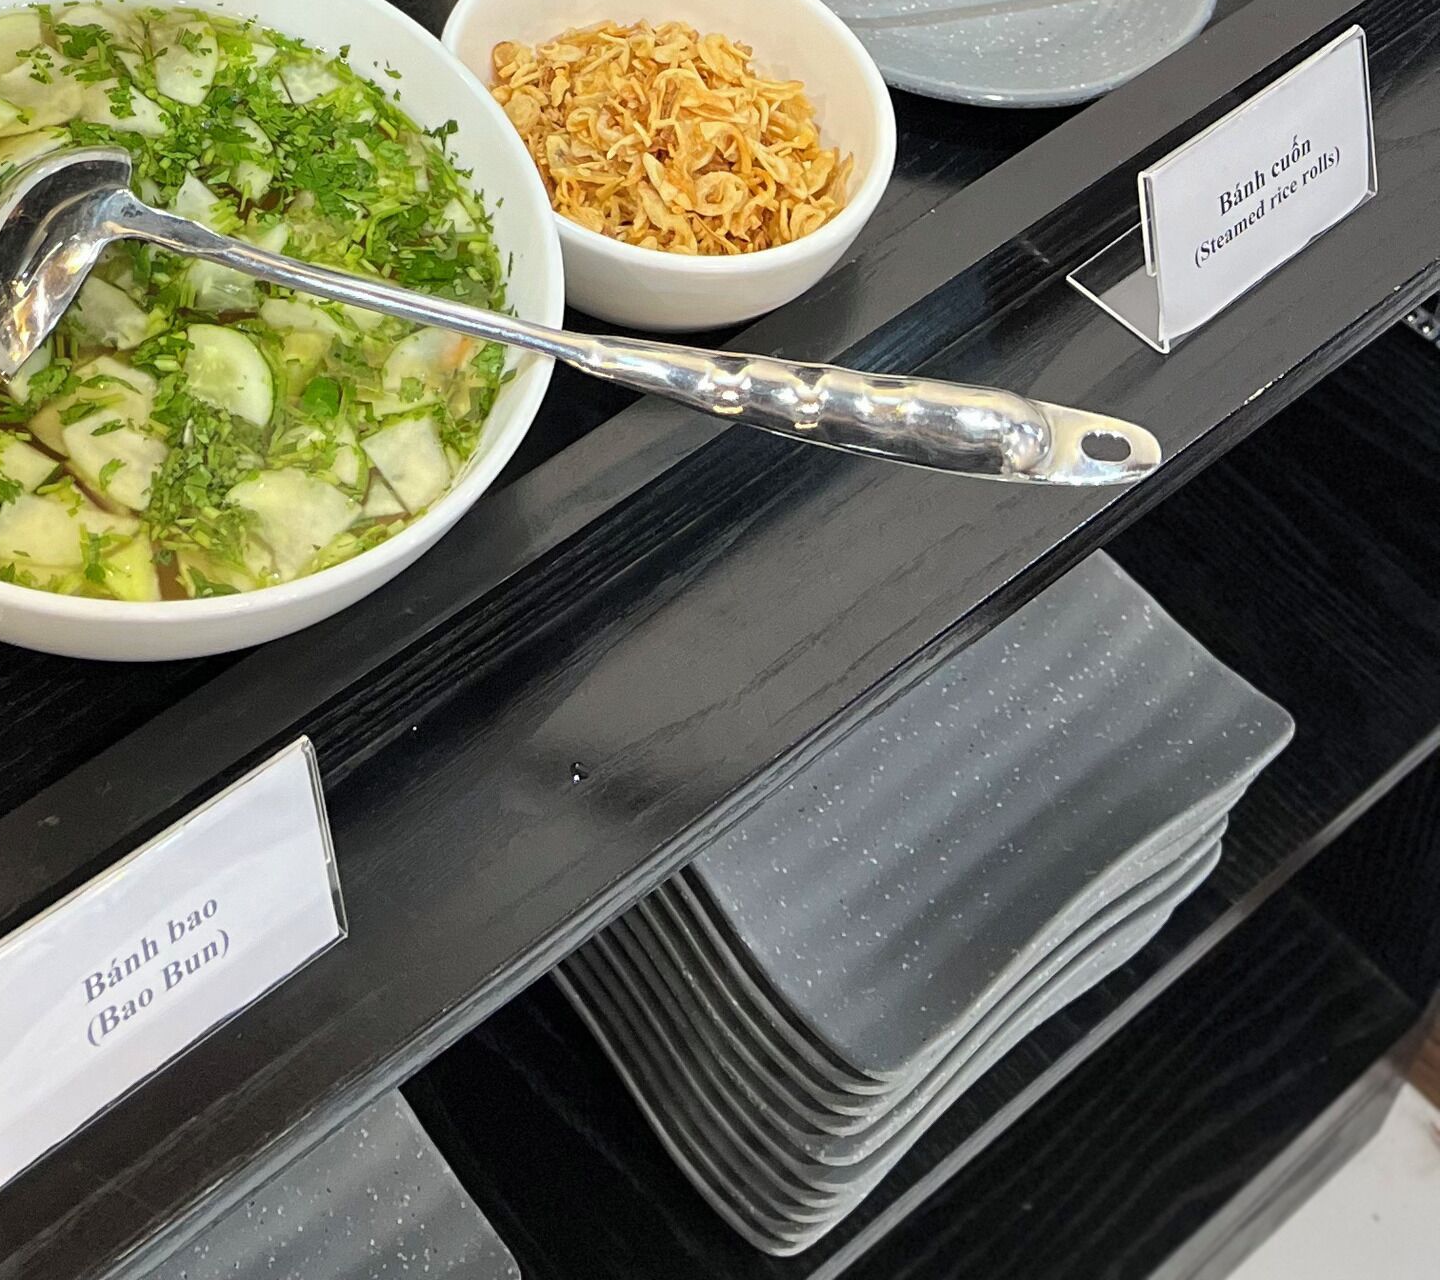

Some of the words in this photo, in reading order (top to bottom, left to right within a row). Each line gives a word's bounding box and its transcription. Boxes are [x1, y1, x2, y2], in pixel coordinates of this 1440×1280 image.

[1193, 198, 1266, 269] (Steamed
[1269, 179, 1298, 214] rice
[1301, 146, 1341, 185] rolls)
[1218, 170, 1266, 217] Bánh
[1270, 134, 1312, 179] cuốn
[81, 936, 160, 1005] Bánh
[167, 897, 219, 947] bao
[86, 987, 155, 1048] (Bao
[160, 928, 231, 993] Bun)
